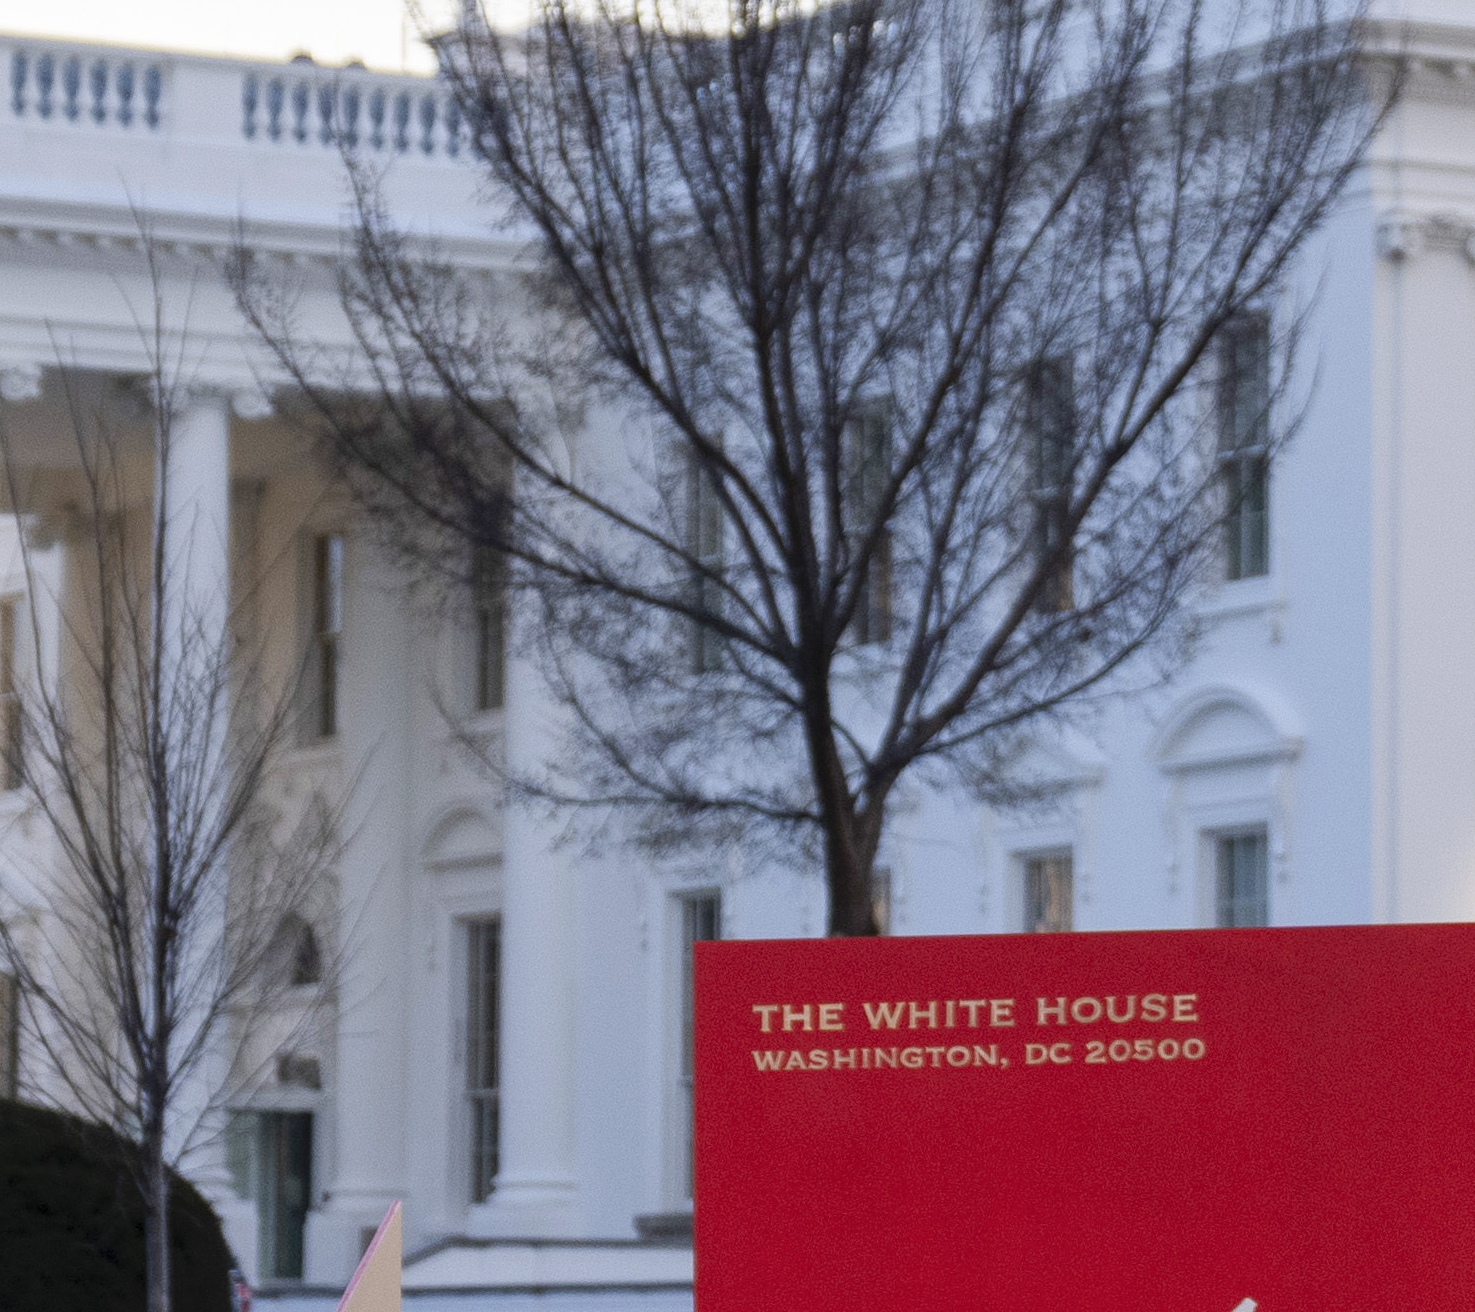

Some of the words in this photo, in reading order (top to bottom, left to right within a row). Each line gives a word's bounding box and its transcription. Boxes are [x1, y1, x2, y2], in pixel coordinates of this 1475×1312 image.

[752, 1002, 845, 1033] THE
[863, 998, 1016, 1030] WHITE
[1035, 993, 1200, 1026] HOUSE
[752, 1044, 1010, 1072] WASHINGTON,
[1025, 1042, 1073, 1066] DC
[1084, 1037, 1207, 1065] 20500
